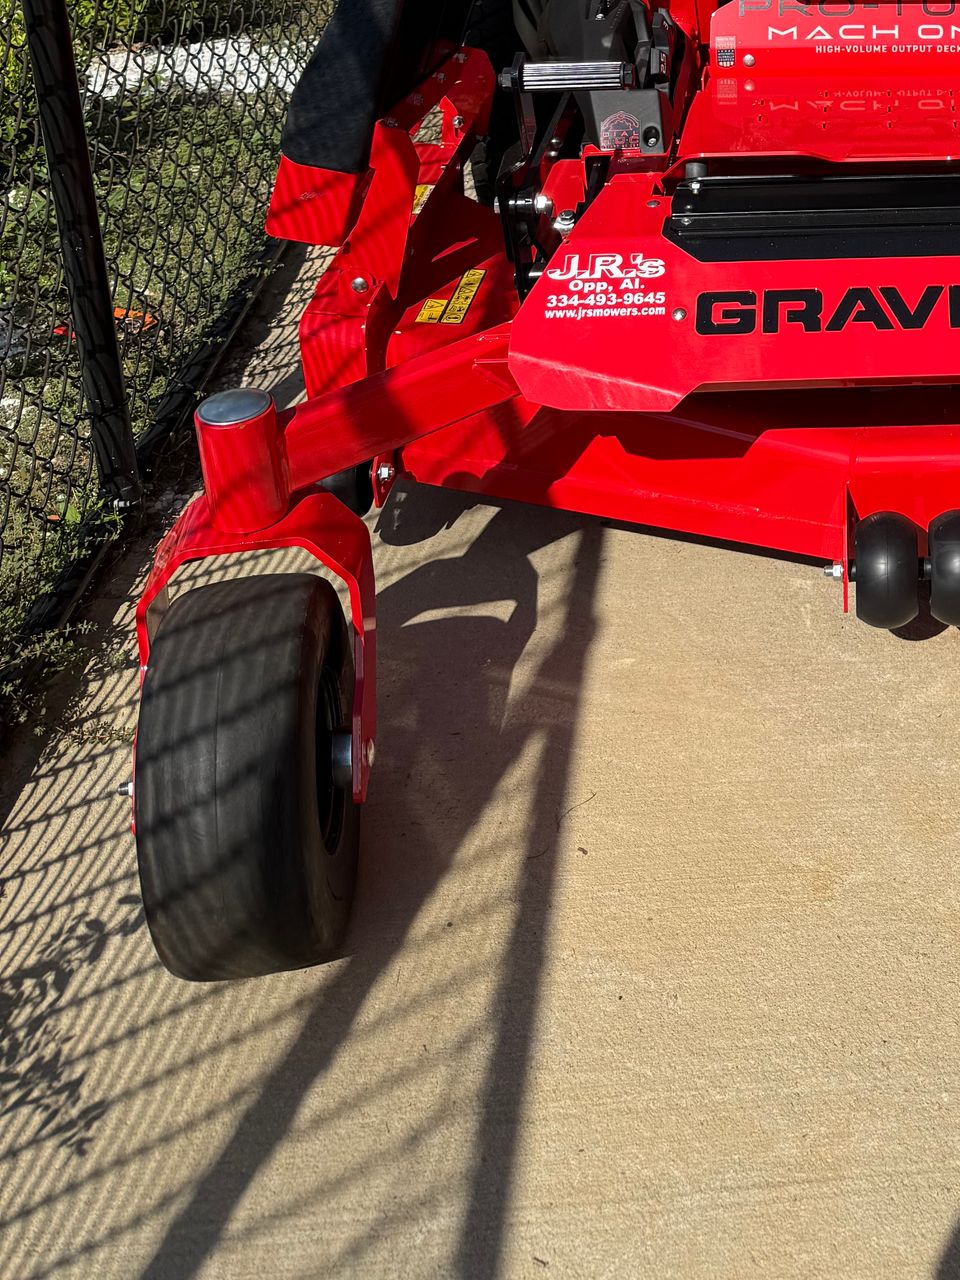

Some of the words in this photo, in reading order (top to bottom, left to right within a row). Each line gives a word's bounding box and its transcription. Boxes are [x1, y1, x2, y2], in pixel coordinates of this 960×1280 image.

[768, 24, 899, 40] MACH
[815, 45, 888, 53] HIGH-VOLUME
[891, 45, 932, 53] OUTPUT
[547, 253, 666, 280] J.R.'s
[568, 280, 613, 293] Opp,
[620, 278, 645, 290] Al.
[546, 292, 666, 308] 334-493-9645
[544, 307, 666, 320] www.jrsmowers.com
